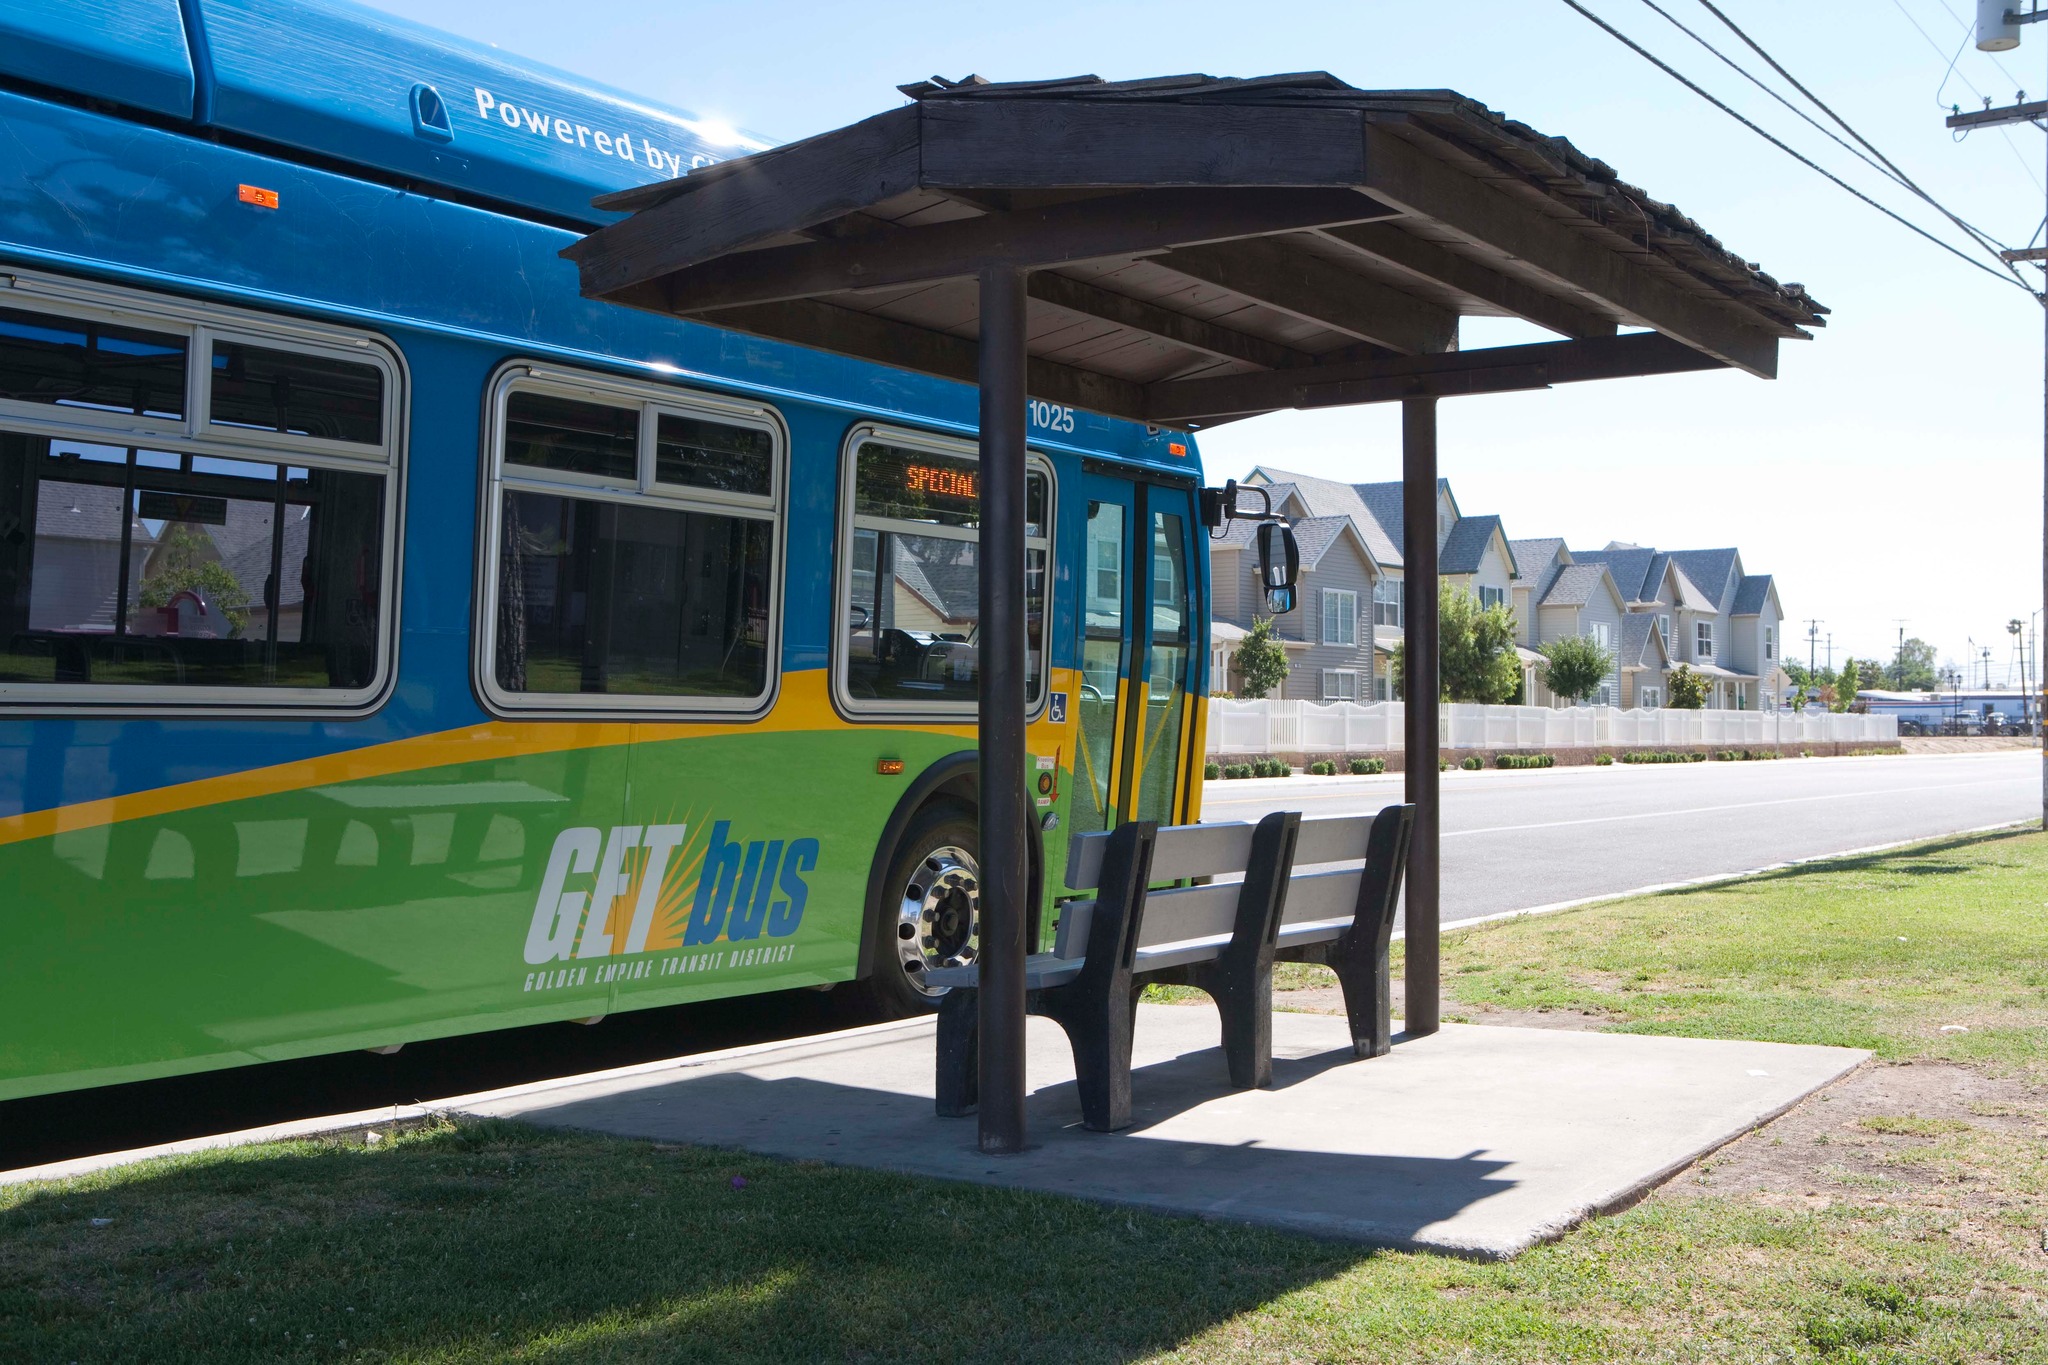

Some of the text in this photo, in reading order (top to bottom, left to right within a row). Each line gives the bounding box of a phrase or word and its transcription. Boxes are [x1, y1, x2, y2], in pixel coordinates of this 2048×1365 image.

[474, 88, 680, 179] Powered by
[1029, 399, 1075, 434] 1025
[907, 464, 977, 498] SPECIAL
[523, 820, 820, 965] GET bus
[523, 944, 796, 992] GOLDEN EMPIRE TRANSIT DISTRICT
